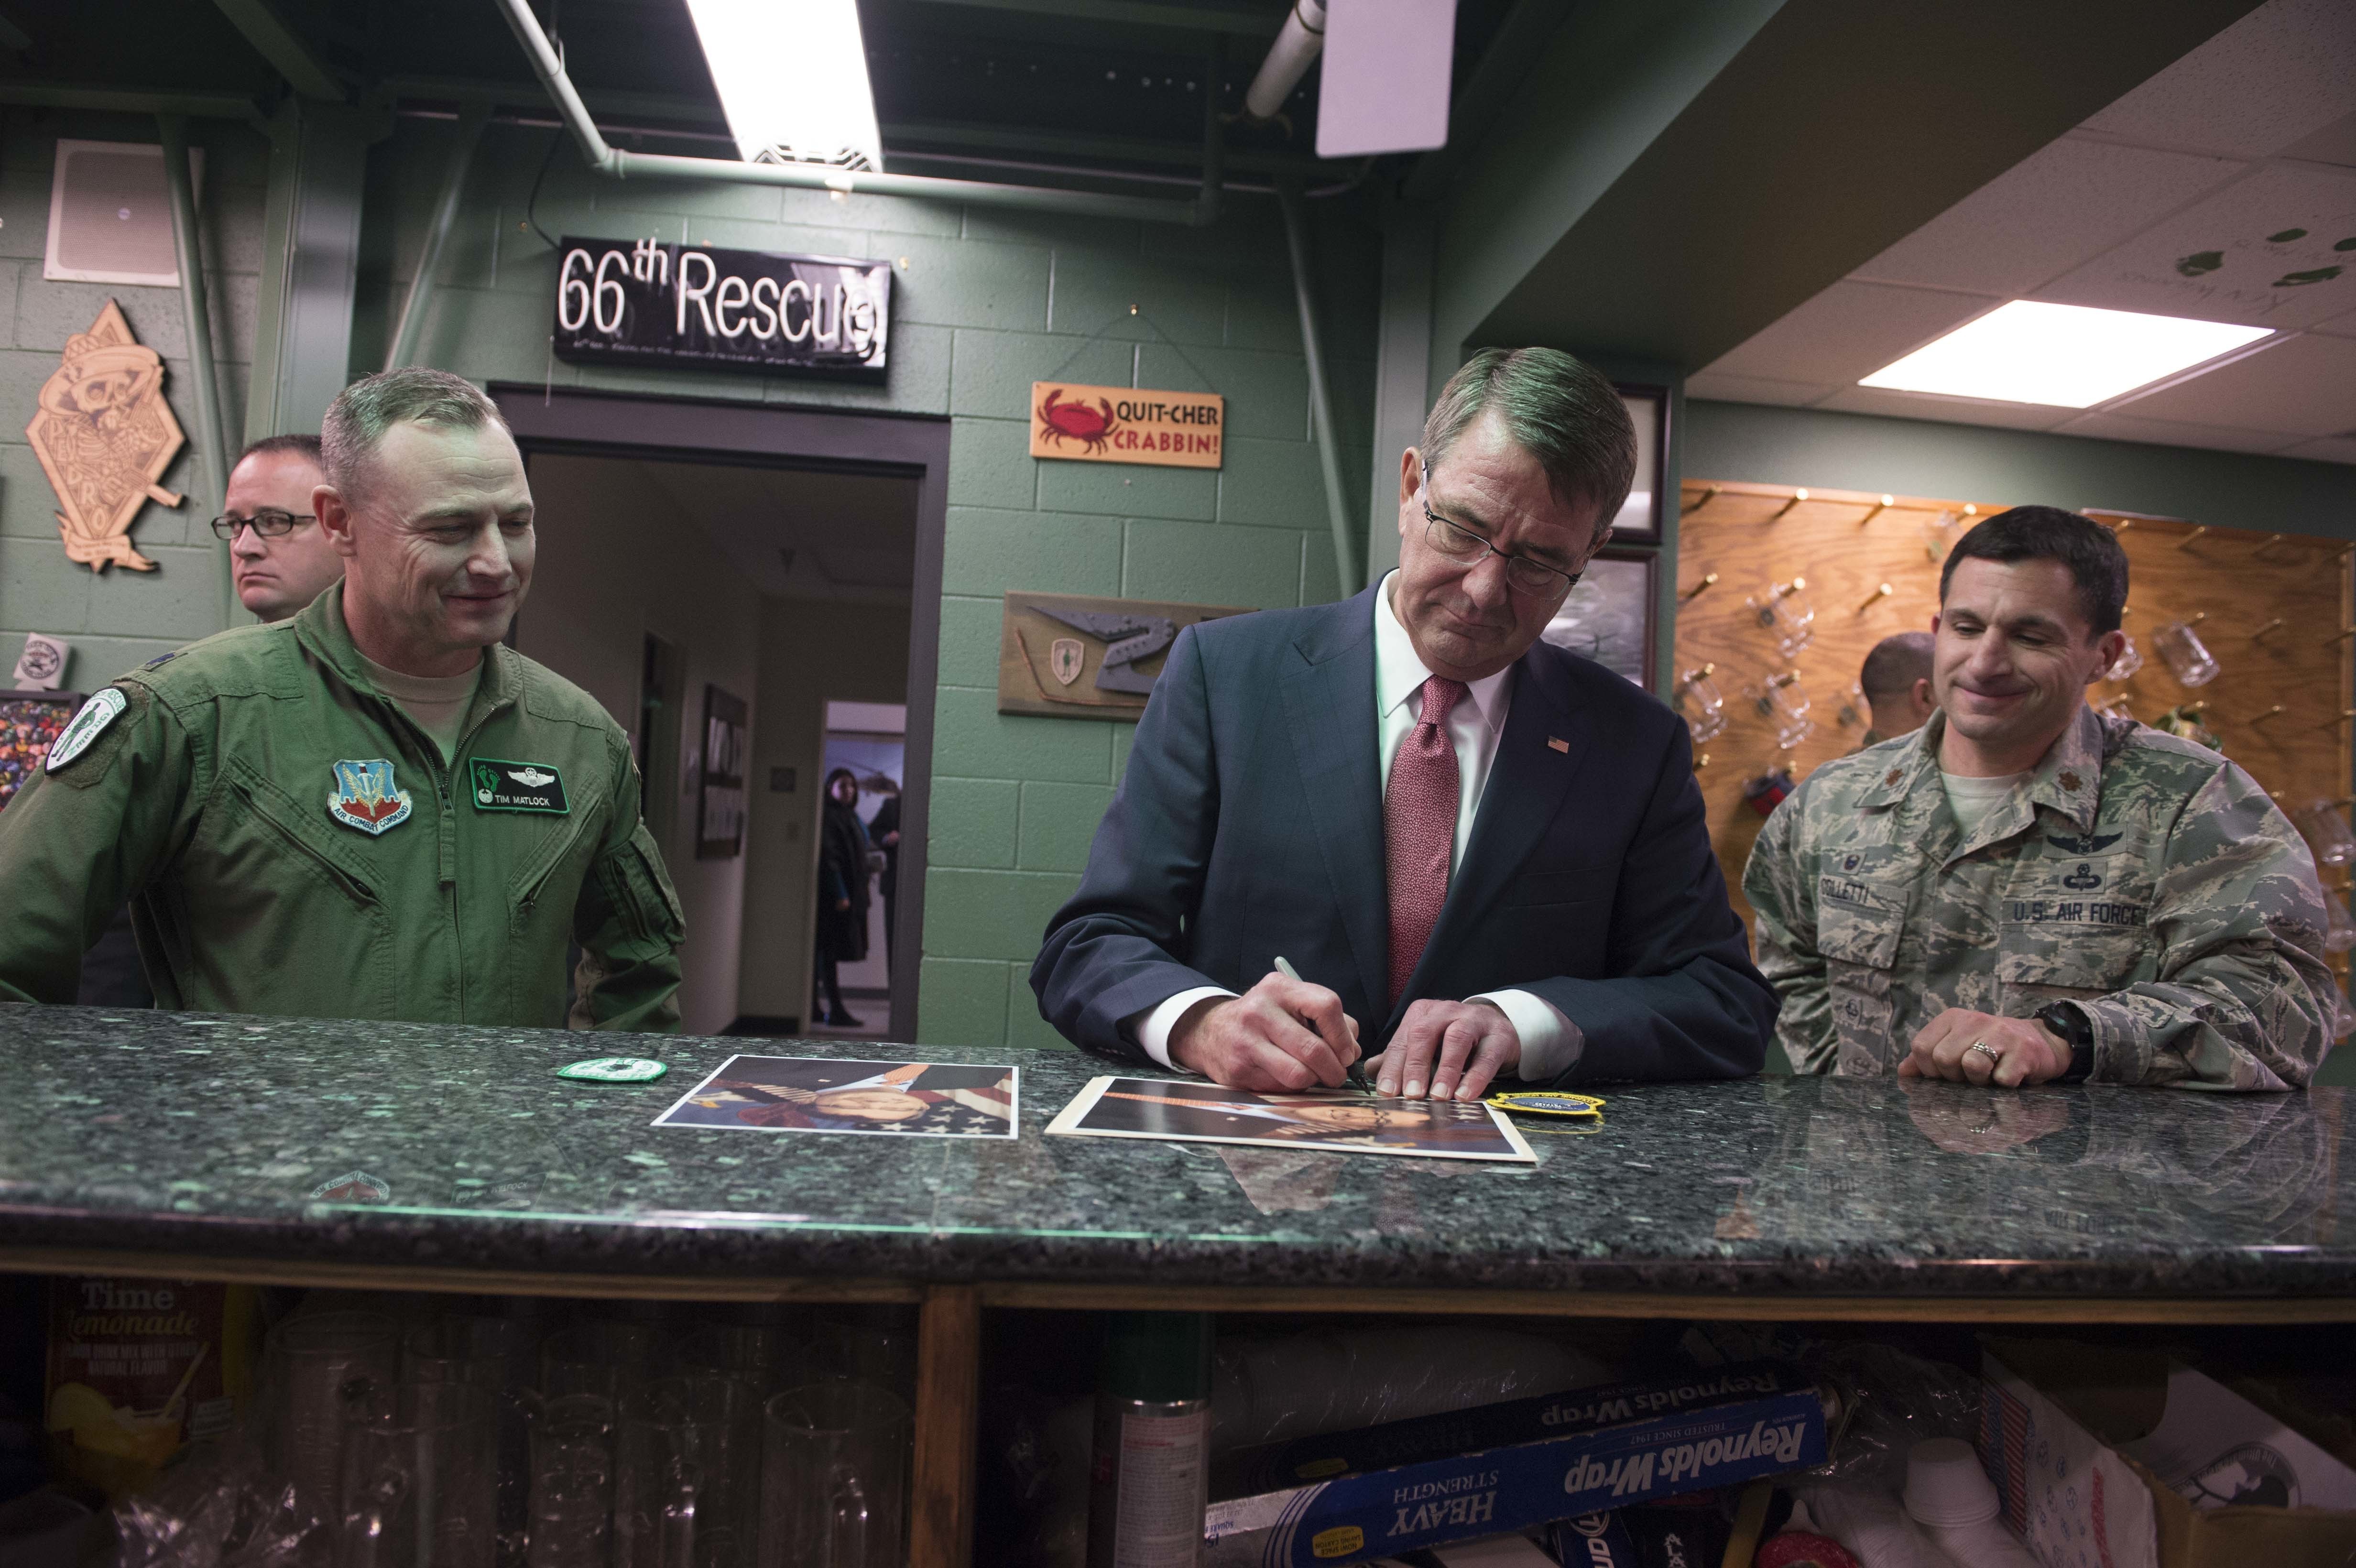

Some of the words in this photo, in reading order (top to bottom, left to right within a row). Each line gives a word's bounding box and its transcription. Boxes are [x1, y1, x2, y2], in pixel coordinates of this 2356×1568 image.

[558, 236, 669, 334] 66th
[676, 251, 879, 345] Rescue
[1116, 401, 1219, 425] QUIT-CHER
[1113, 430, 1219, 455] CRABBIN!
[494, 795, 510, 804] TIM
[513, 795, 550, 806] MATLOCK
[334, 807, 347, 820] AIR
[349, 816, 379, 832] COMBAT
[379, 805, 409, 828] COMMAND
[2013, 901, 2049, 922] U.S.
[2056, 902, 2083, 922] AIR
[2089, 902, 2140, 926] FORCE
[81, 1281, 176, 1310] Time
[1634, 1372, 1779, 1411] Reynolds
[1540, 1398, 1635, 1426] Wrap
[1630, 1432, 1651, 1445] 1947
[1652, 1428, 1681, 1441] SINCE
[1682, 1422, 1726, 1437] TRUSTED
[1658, 1420, 1806, 1482] Reynolds
[1394, 1470, 1499, 1504] STRENGTH
[1564, 1454, 1657, 1497] Wrap
[1387, 1491, 1497, 1536] HEAVY
[1211, 1521, 1233, 1532] SQUARE
[1315, 1538, 1340, 1549] CARTON
[1321, 1545, 1340, 1556] SPACE
[1341, 1534, 1361, 1545] SAVING
[1587, 1537, 1614, 1568] UD
